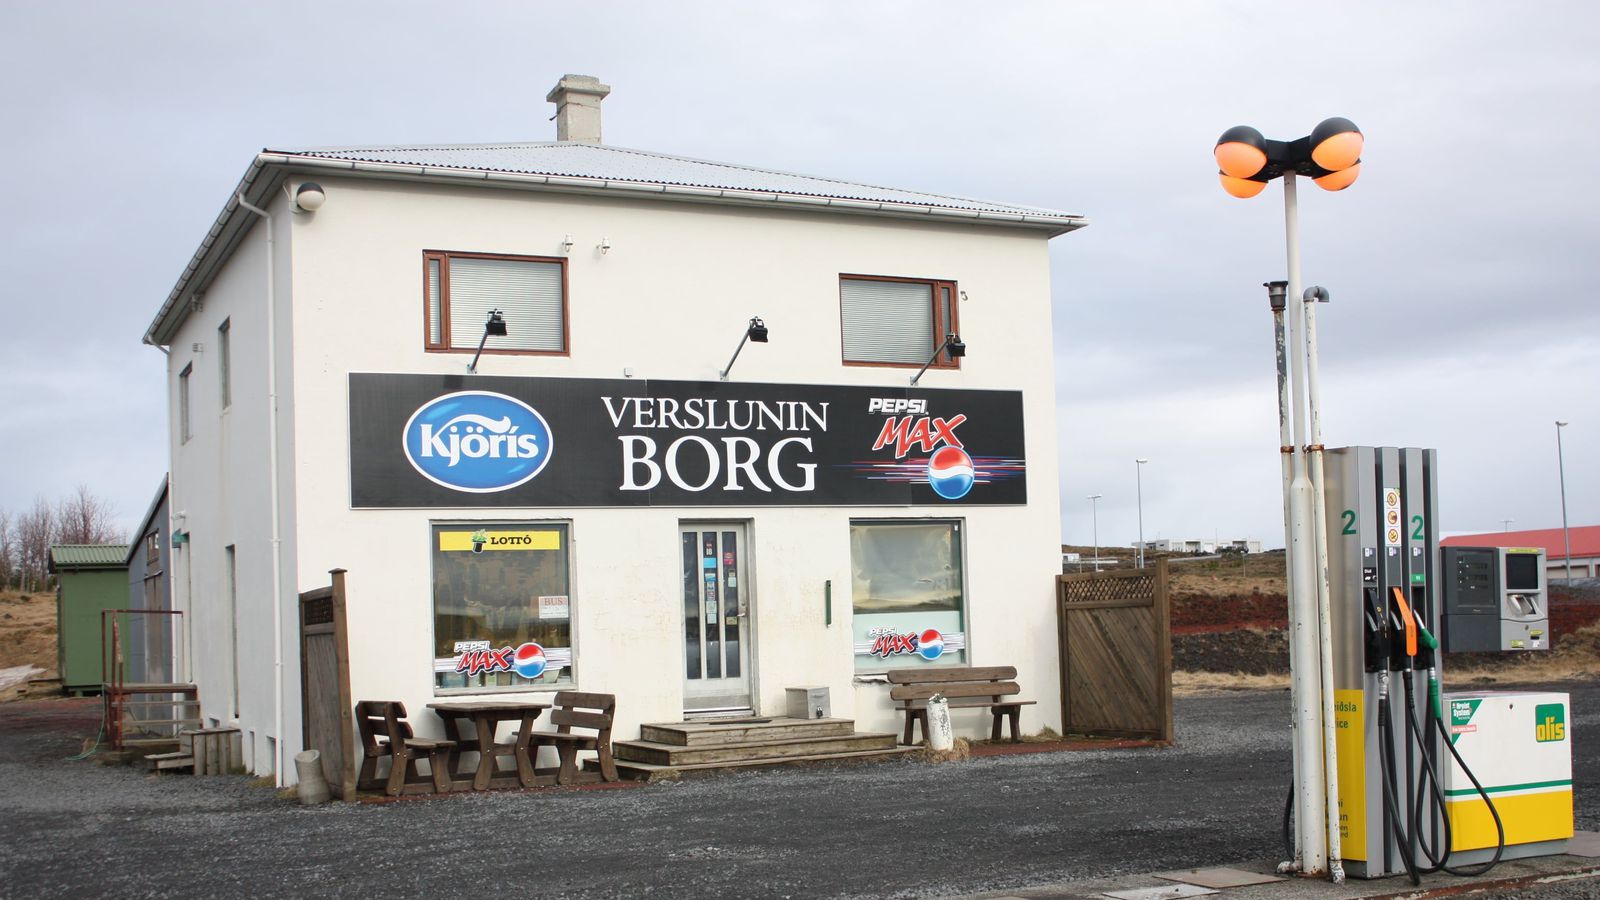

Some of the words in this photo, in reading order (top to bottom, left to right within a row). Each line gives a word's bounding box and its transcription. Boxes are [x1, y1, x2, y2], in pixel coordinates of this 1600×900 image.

[601, 396, 829, 431] VERSLUNIN
[868, 398, 927, 415] PEPSI
[420, 422, 539, 467] Kjörís
[872, 414, 967, 459] MAX
[618, 435, 818, 492] BORG
[1341, 510, 1357, 535] 2
[1411, 515, 1424, 540] 2
[491, 535, 532, 545] LOTTÓ
[870, 627, 897, 635] PEPSI
[455, 641, 490, 652] PEPSI
[870, 632, 917, 658] MAX
[456, 647, 513, 676] MAX
